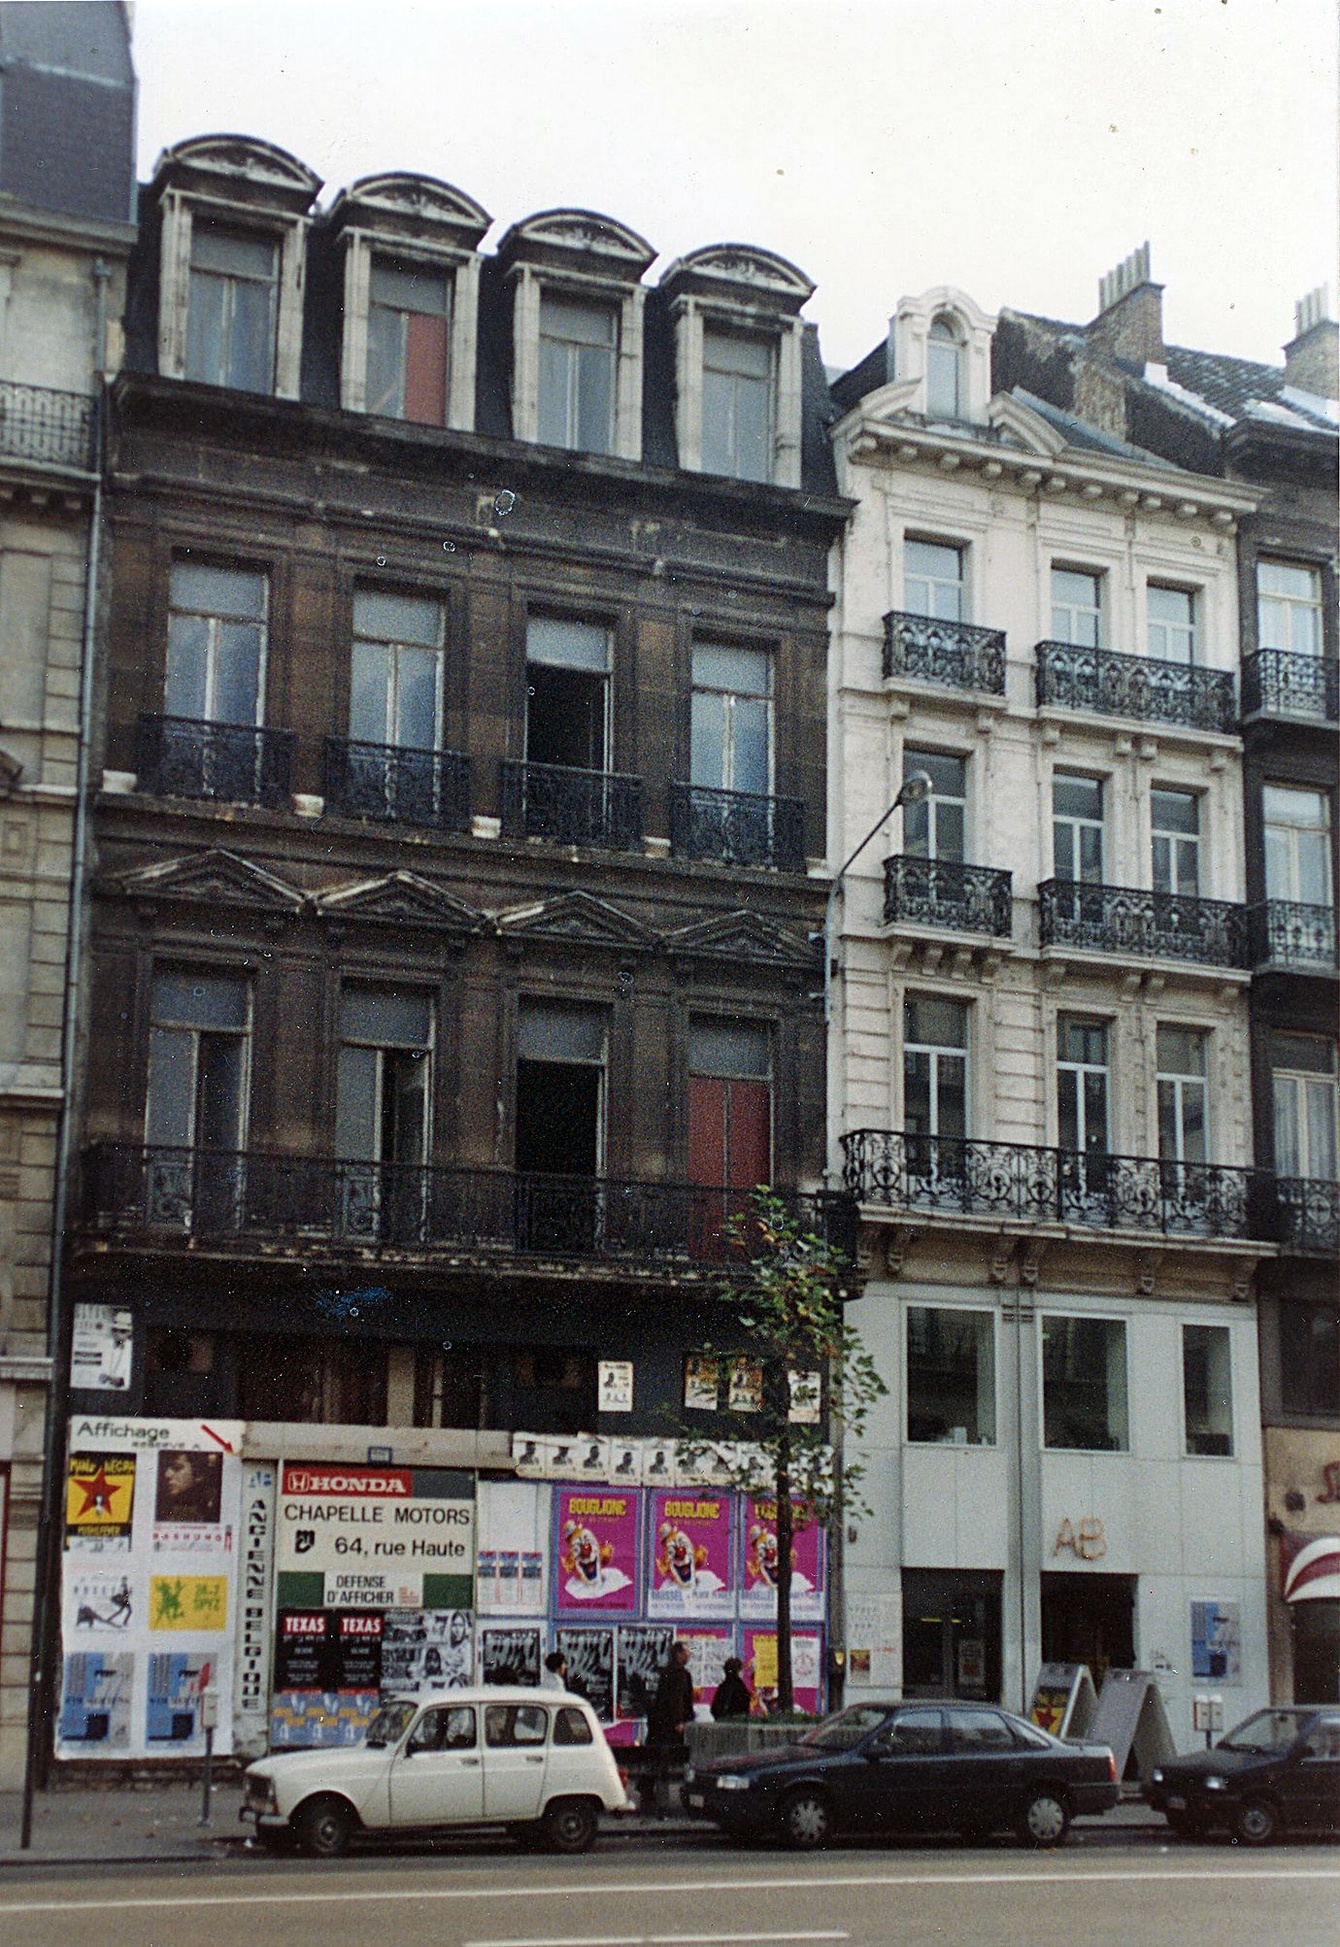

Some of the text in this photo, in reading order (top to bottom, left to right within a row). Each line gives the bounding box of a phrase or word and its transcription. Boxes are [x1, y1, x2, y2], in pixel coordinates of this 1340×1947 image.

[77, 1422, 170, 1441] Affichage
[310, 1476, 406, 1494] HONDA
[284, 1503, 470, 1526] CHAPELLE MOTORS
[334, 1536, 466, 1558] 64, rue Haute
[1053, 1517, 1108, 1561] AB
[336, 1575, 386, 1588] DEFENSE
[242, 1500, 267, 1709] ANCIENNE BELGIQUE
[285, 1616, 326, 1633] TEXAS
[342, 1617, 382, 1633] TEXAS
